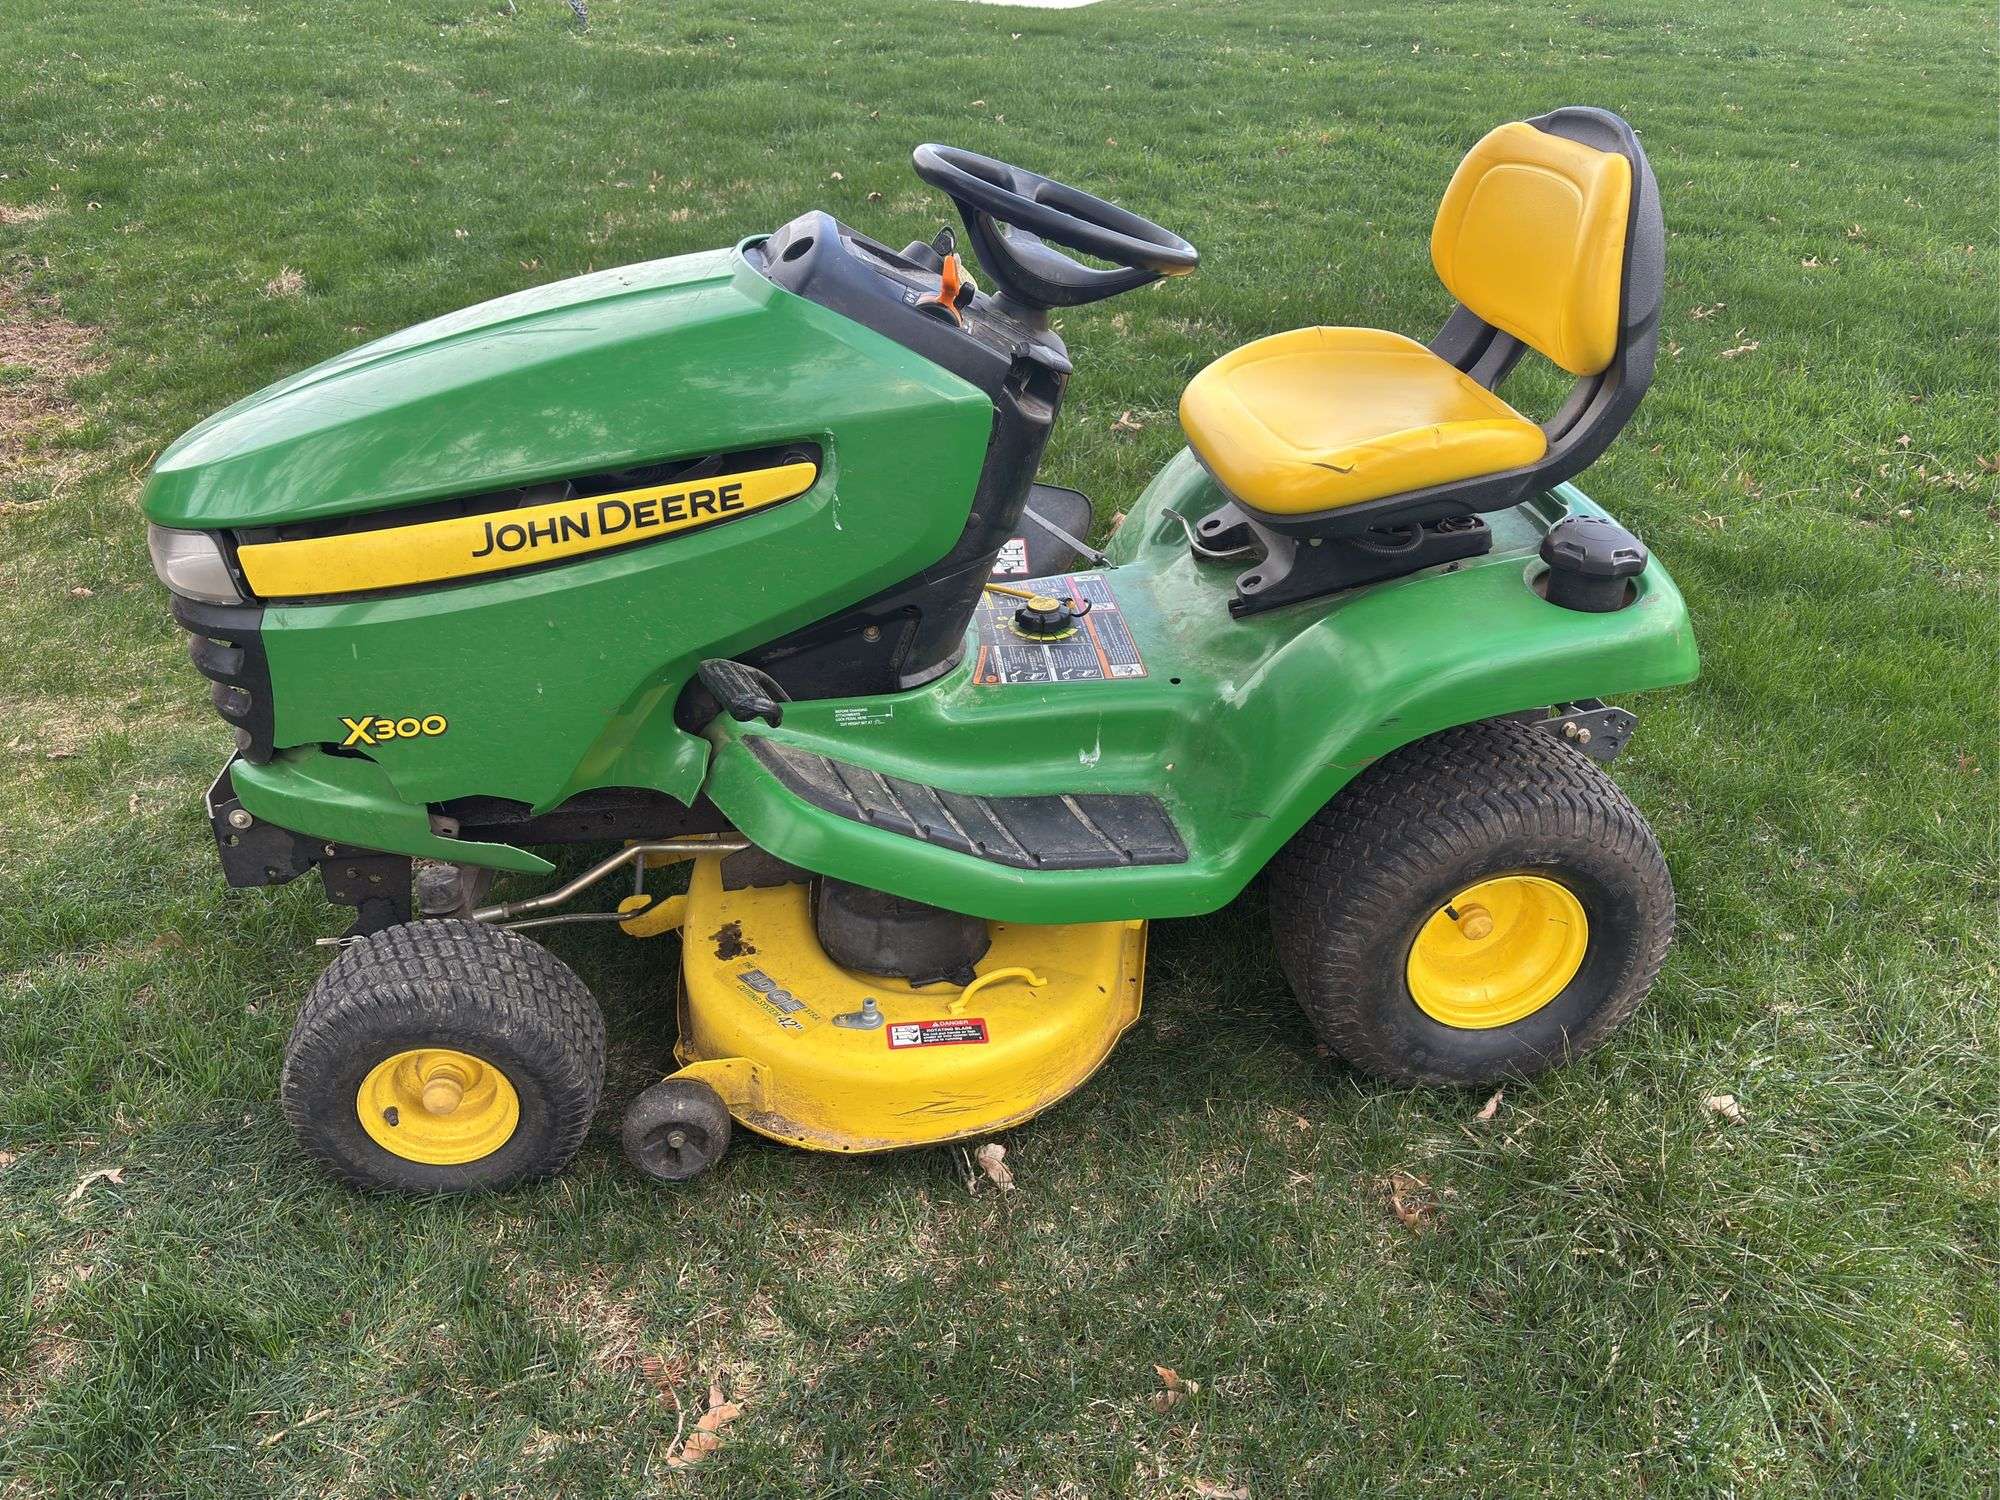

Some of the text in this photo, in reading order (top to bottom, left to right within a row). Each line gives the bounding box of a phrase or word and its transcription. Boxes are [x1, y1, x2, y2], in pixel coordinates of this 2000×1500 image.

[472, 483, 744, 557] JOHN DEERE
[339, 714, 447, 746] X300
[736, 969, 807, 1014] EDGE
